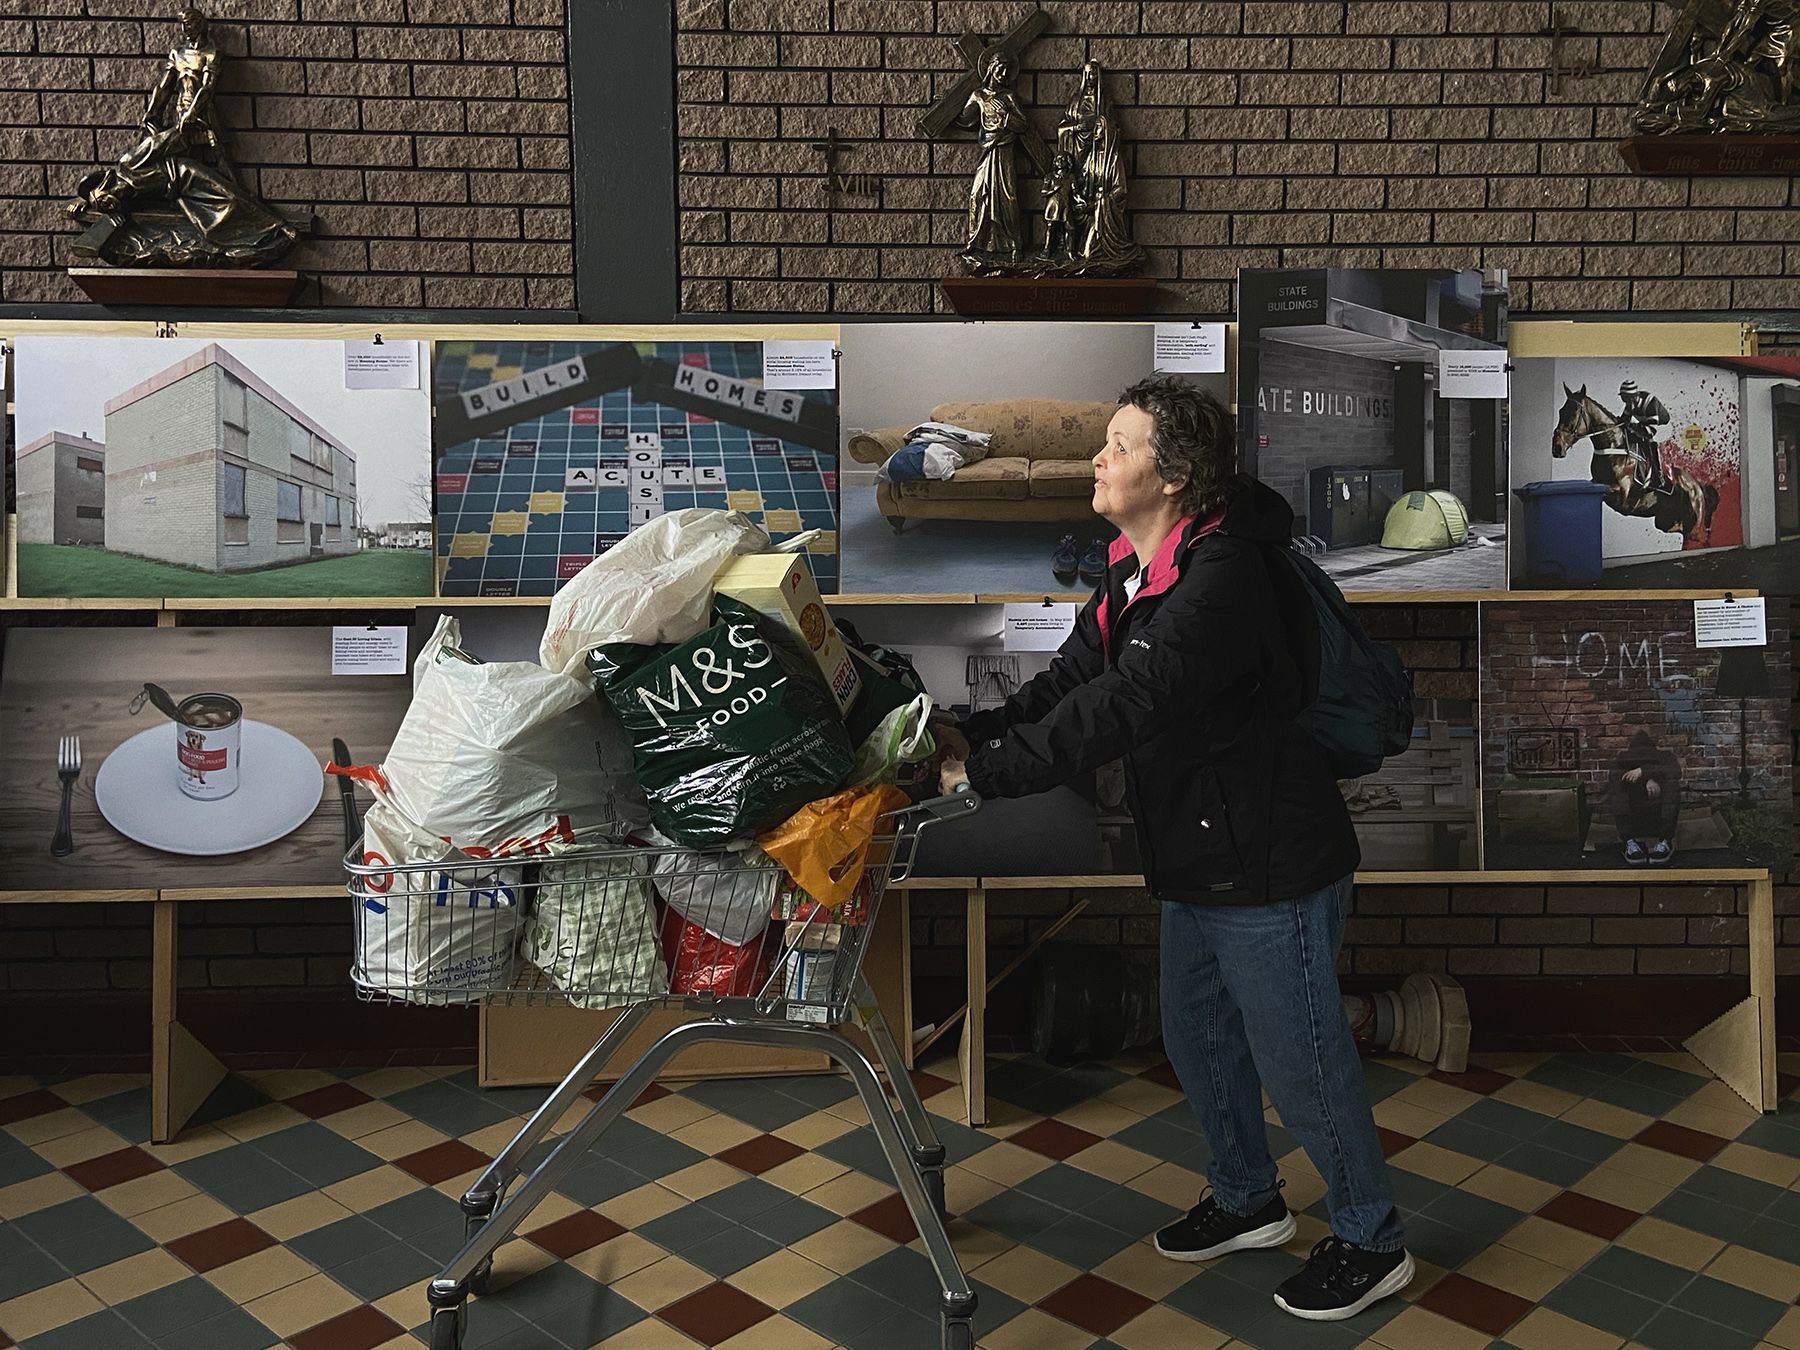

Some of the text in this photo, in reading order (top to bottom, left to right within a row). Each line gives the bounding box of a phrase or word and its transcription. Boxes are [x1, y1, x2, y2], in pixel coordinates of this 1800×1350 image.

[838, 174, 871, 196] VIII
[1268, 300, 1318, 312] BUILDINGS
[1278, 286, 1308, 296] STATE
[470, 363, 581, 410] BUILD
[680, 368, 794, 414] HOMES
[1258, 387, 1390, 418] ATE BUILDINGS
[573, 468, 716, 480] ACUTE
[635, 435, 654, 520] HOUSI
[636, 624, 773, 729] M&S
[833, 657, 850, 692] FLAKES
[1530, 630, 1690, 688] HOME
[837, 671, 859, 706] CORN
[696, 686, 767, 732] FOOD
[672, 802, 686, 813] We
[688, 785, 716, 805] recycle
[770, 741, 790, 758] from
[717, 790, 732, 802] and
[762, 764, 778, 776] into
[780, 750, 802, 766] these
[466, 956, 486, 968] 80%
